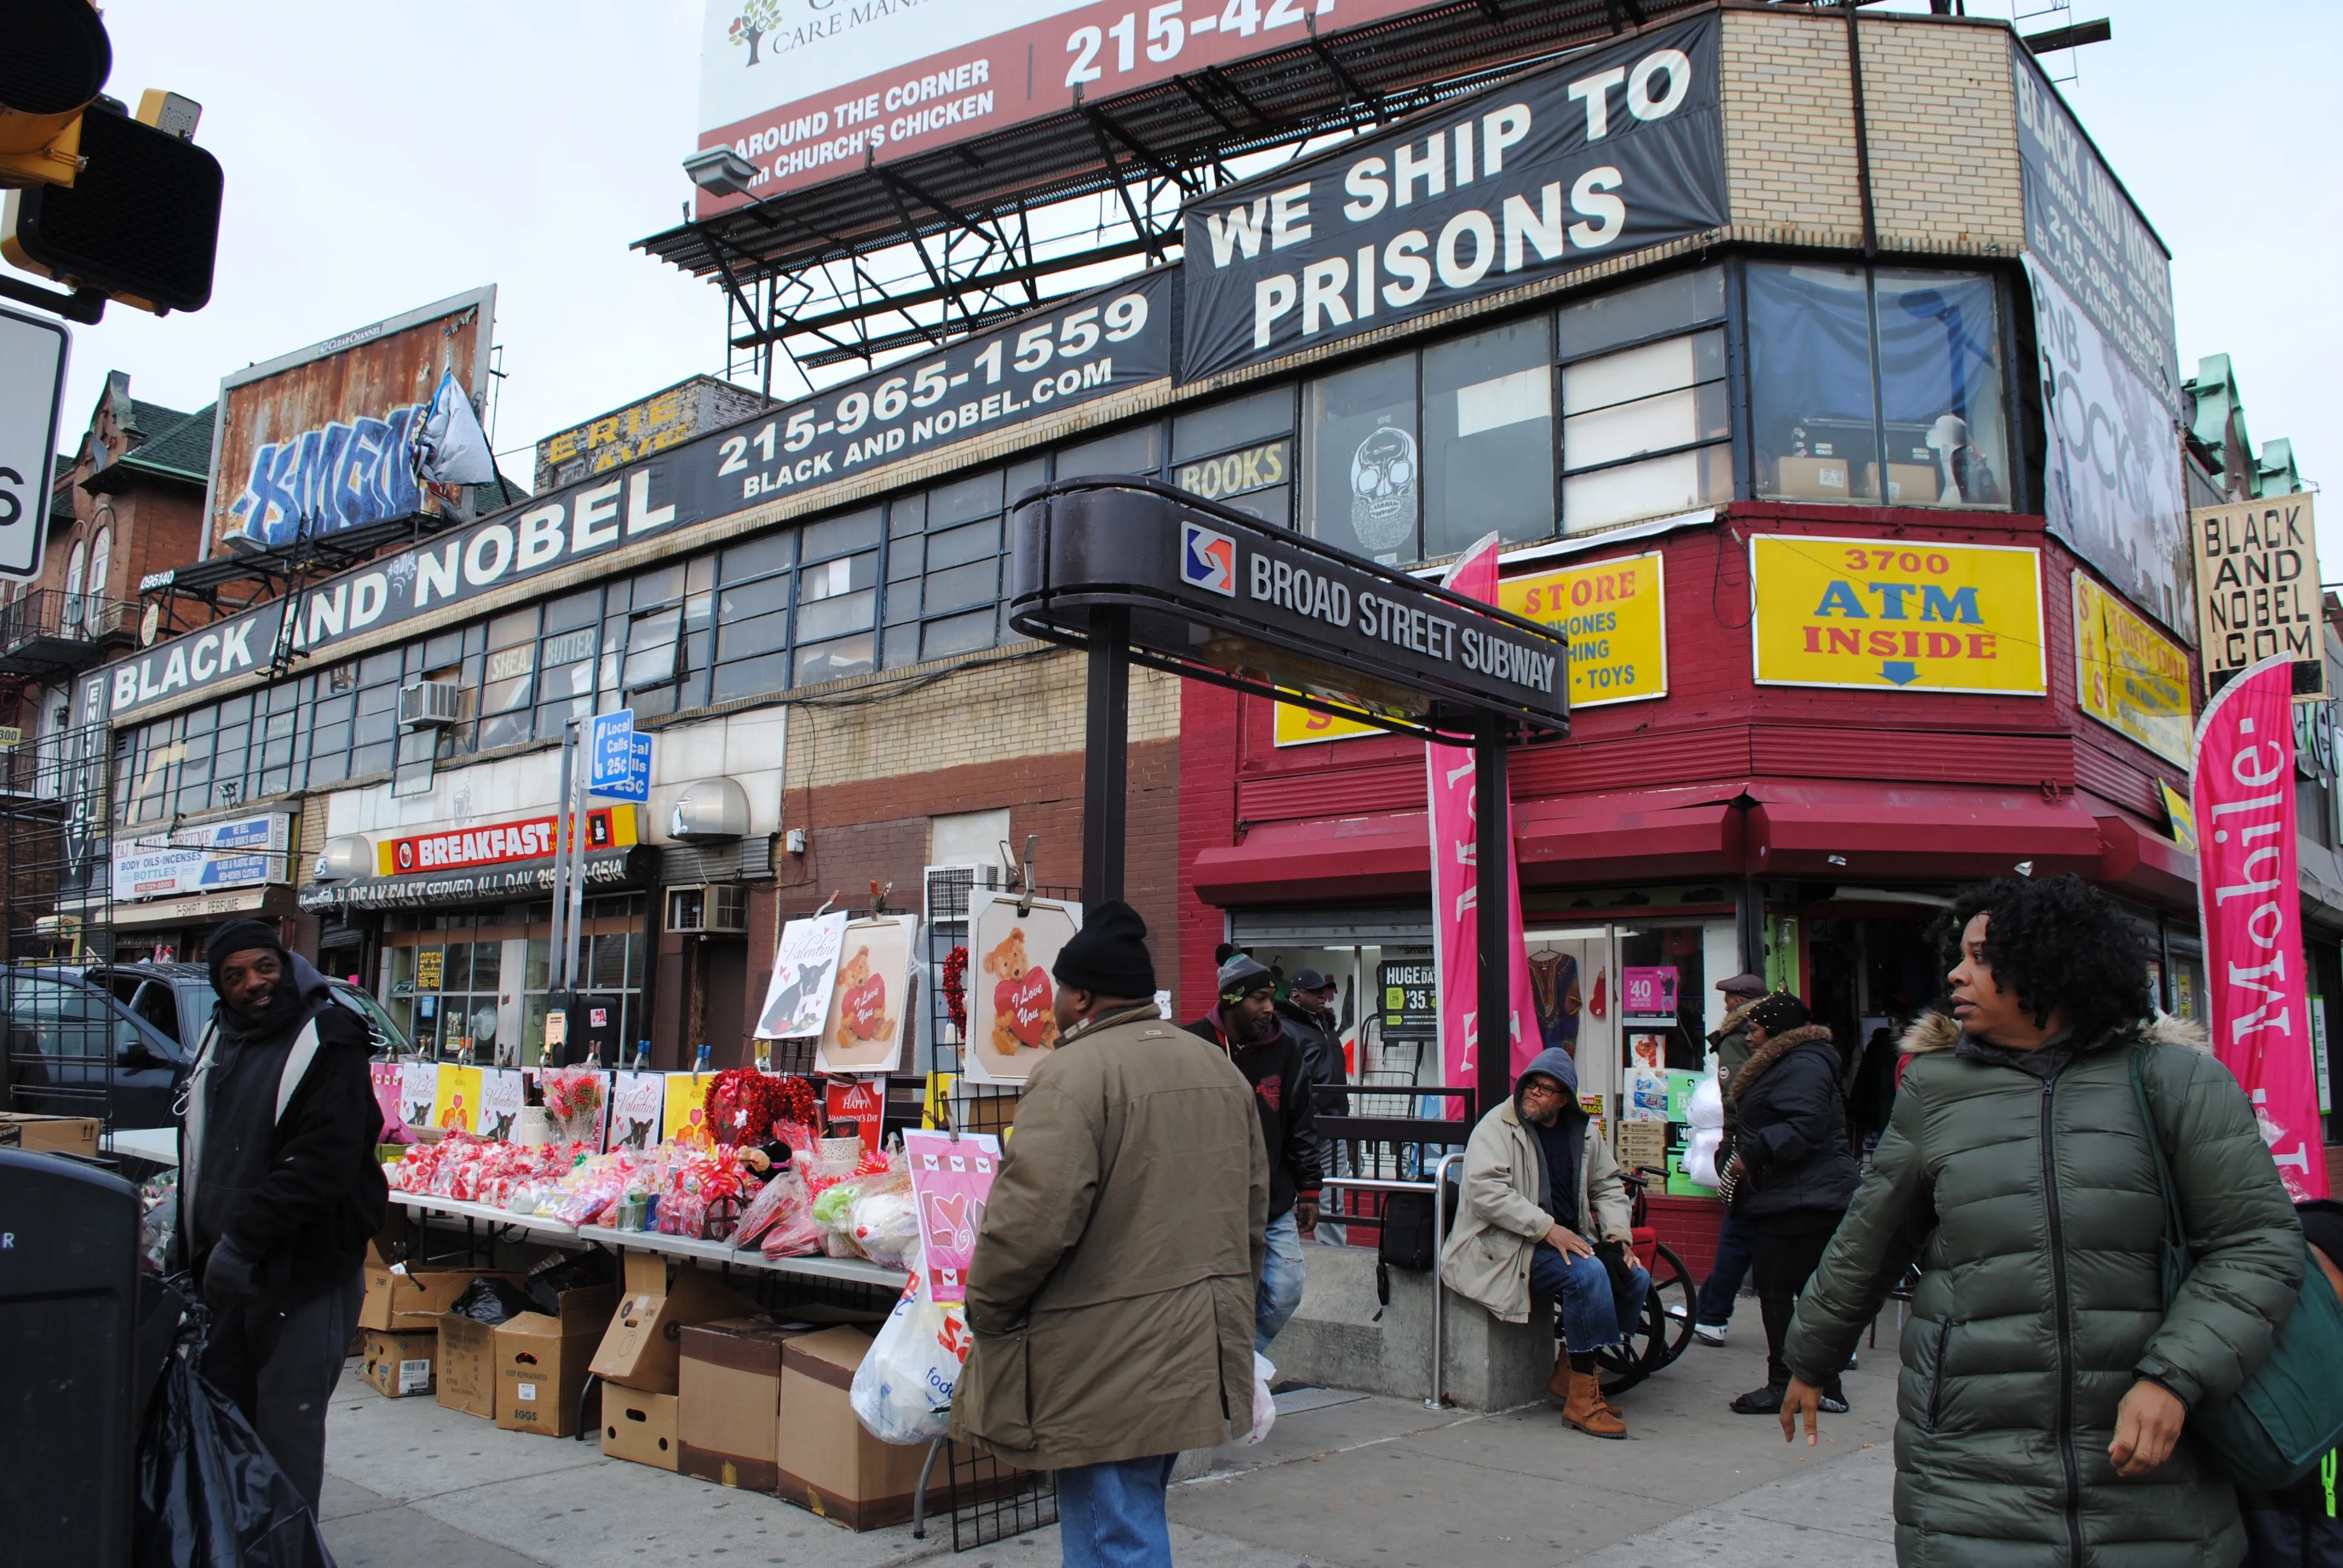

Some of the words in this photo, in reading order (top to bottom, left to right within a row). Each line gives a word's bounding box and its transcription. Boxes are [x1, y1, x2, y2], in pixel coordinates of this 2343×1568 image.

[773, 13, 842, 54] CARE
[735, 111, 829, 160] AROUND
[834, 94, 879, 128] THE
[885, 59, 989, 111] CORNER
[890, 90, 994, 141] CHICKEN
[1207, 181, 1312, 269] WE
[1343, 103, 1530, 222] SHIP
[1567, 49, 1691, 141] TO
[2016, 58, 2082, 197] BLACK
[2086, 158, 2119, 244] AND
[2123, 207, 2172, 319] NOBEL
[1254, 166, 1626, 350] PRISONS
[2044, 161, 2117, 272] WHOLESALE
[2127, 272, 2162, 330] RETAIL
[2034, 223, 2082, 297] BLACK
[2085, 290, 2111, 332] AND
[718, 293, 1148, 477] 215-965-1559
[549, 391, 680, 463] ERIE
[743, 451, 833, 499] BLACK
[842, 427, 905, 468] AND
[911, 358, 1112, 444] NOBEL.COM
[1182, 443, 1282, 500] BOOKS
[2204, 506, 2304, 557] BLACK
[1844, 549, 1950, 574] 3700
[2214, 549, 2302, 590] AND
[112, 618, 257, 711] BLACK
[269, 572, 388, 656] AND
[415, 470, 675, 607] NOBEL
[1525, 570, 1636, 615] STORE
[1814, 580, 1985, 624] ATM
[1251, 552, 1351, 627] BROAD
[1358, 591, 1457, 661] STREET
[1461, 627, 1555, 693] SUBWAY
[2209, 584, 2310, 633] NOBEL
[491, 647, 528, 679] SHEA
[546, 629, 596, 666] BUTTER
[1803, 626, 1997, 659] INSIDE
[1588, 665, 1635, 690] TOYS
[607, 718, 629, 736] Local
[607, 738, 628, 754] Calls
[632, 743, 649, 755] cal
[607, 757, 627, 776] 25¢
[115, 844, 129, 858] TAJ
[133, 838, 162, 855] MAHAL
[169, 830, 211, 846] PERFUME
[419, 822, 551, 867] BREAKFAST
[121, 860, 140, 871] BODY
[134, 866, 177, 881] BOTTLES
[427, 879, 473, 901] SERVED
[478, 876, 503, 897] ALL
[506, 871, 533, 892] DAY
[420, 952, 442, 963] OPEN
[784, 932, 837, 961] Valentine
[1386, 967, 1420, 984] HUGE
[1630, 980, 1651, 998] $40
[860, 987, 879, 1007] Love
[1020, 983, 1043, 1004] Love
[857, 1007, 874, 1024] You
[1017, 1007, 1040, 1027] You
[404, 1079, 434, 1098] Valentine
[485, 1086, 519, 1108] Valentine
[617, 1091, 657, 1114] Valentine
[843, 1099, 868, 1109] HAPPY
[867, 1114, 878, 1122] DAY
[514, 1410, 537, 1421] EGGS
